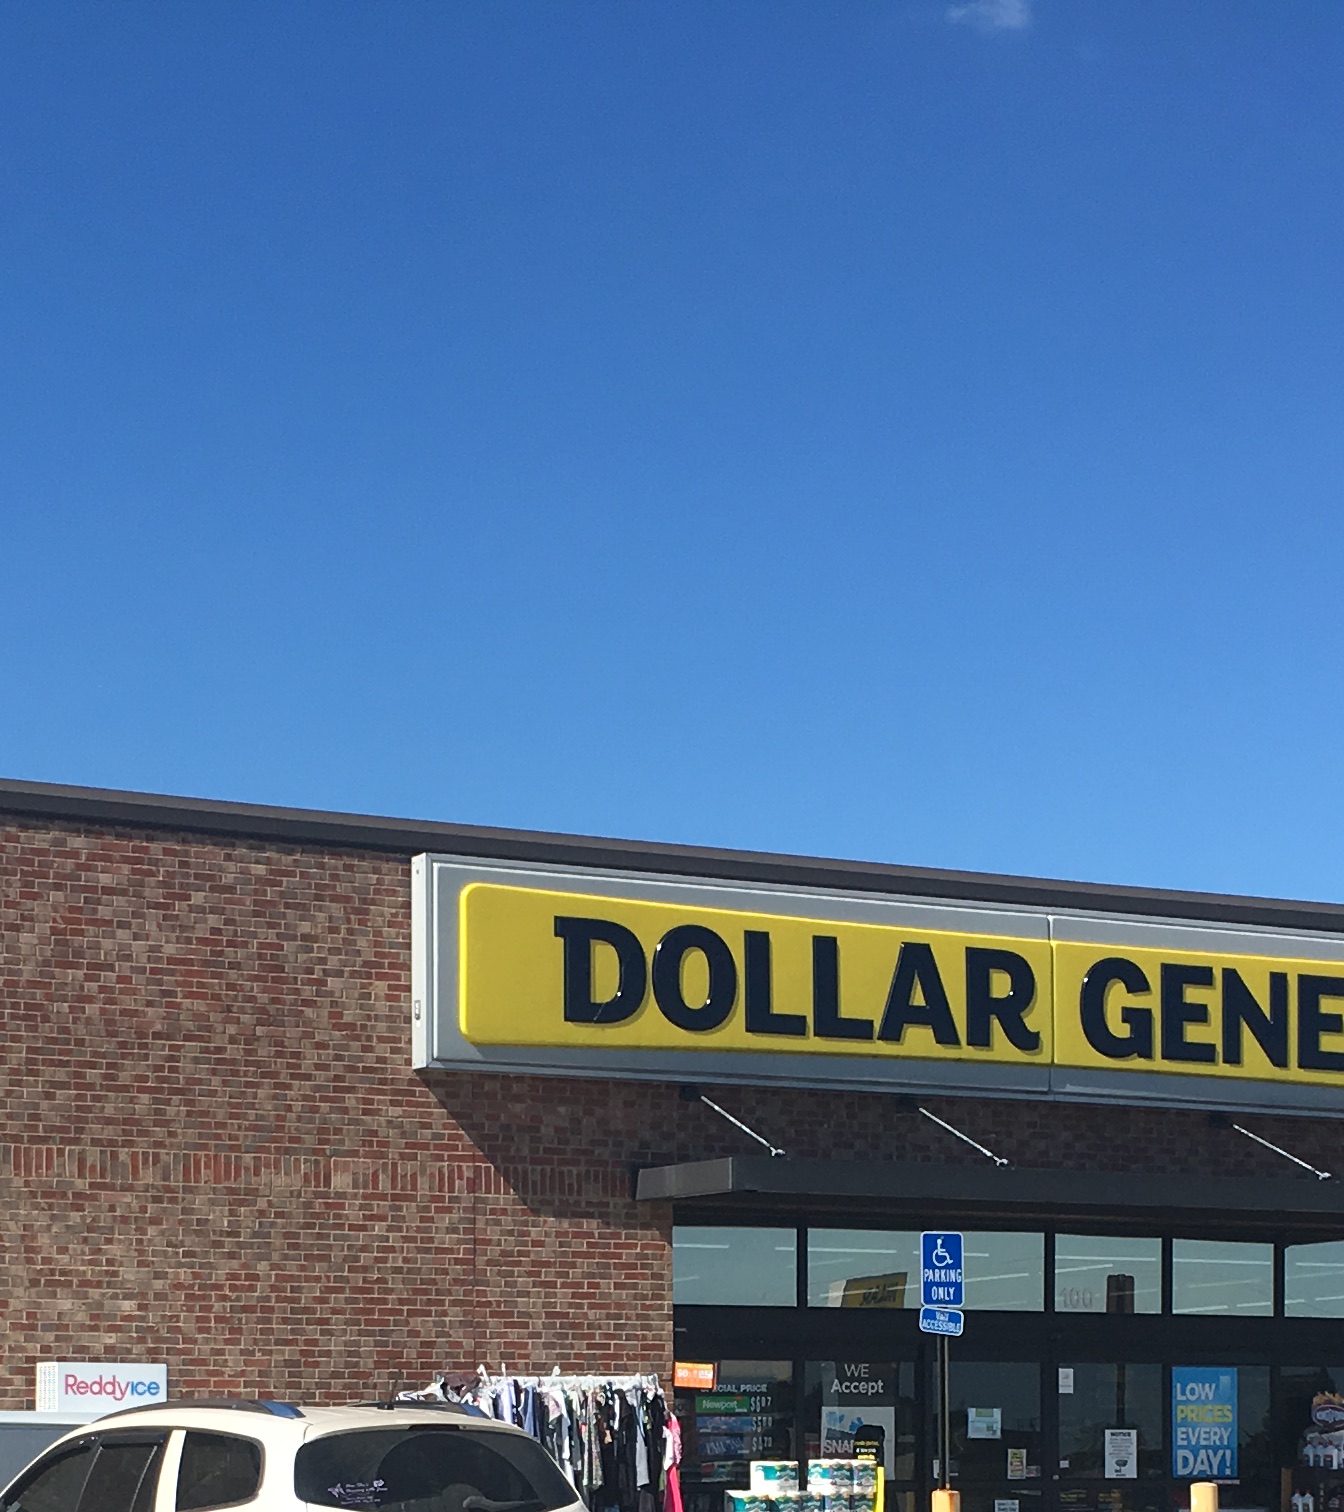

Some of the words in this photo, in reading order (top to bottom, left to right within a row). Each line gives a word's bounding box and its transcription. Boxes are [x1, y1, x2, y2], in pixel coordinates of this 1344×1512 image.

[553, 915, 1043, 1053] DOLLAR
[924, 1268, 962, 1283] PARKING
[931, 1285, 956, 1301] ONLY
[922, 1318, 961, 1333] ACCESSIBLE
[844, 1363, 870, 1378] WE
[700, 1384, 737, 1393] CIAL
[740, 1384, 768, 1393] PRICE
[830, 1378, 884, 1396] Accept
[1176, 1382, 1216, 1402] LOW
[702, 1399, 738, 1410] Newport
[1177, 1404, 1233, 1423] PRICES
[1176, 1426, 1232, 1446] EVERY
[1176, 1449, 1232, 1476] DAY!
